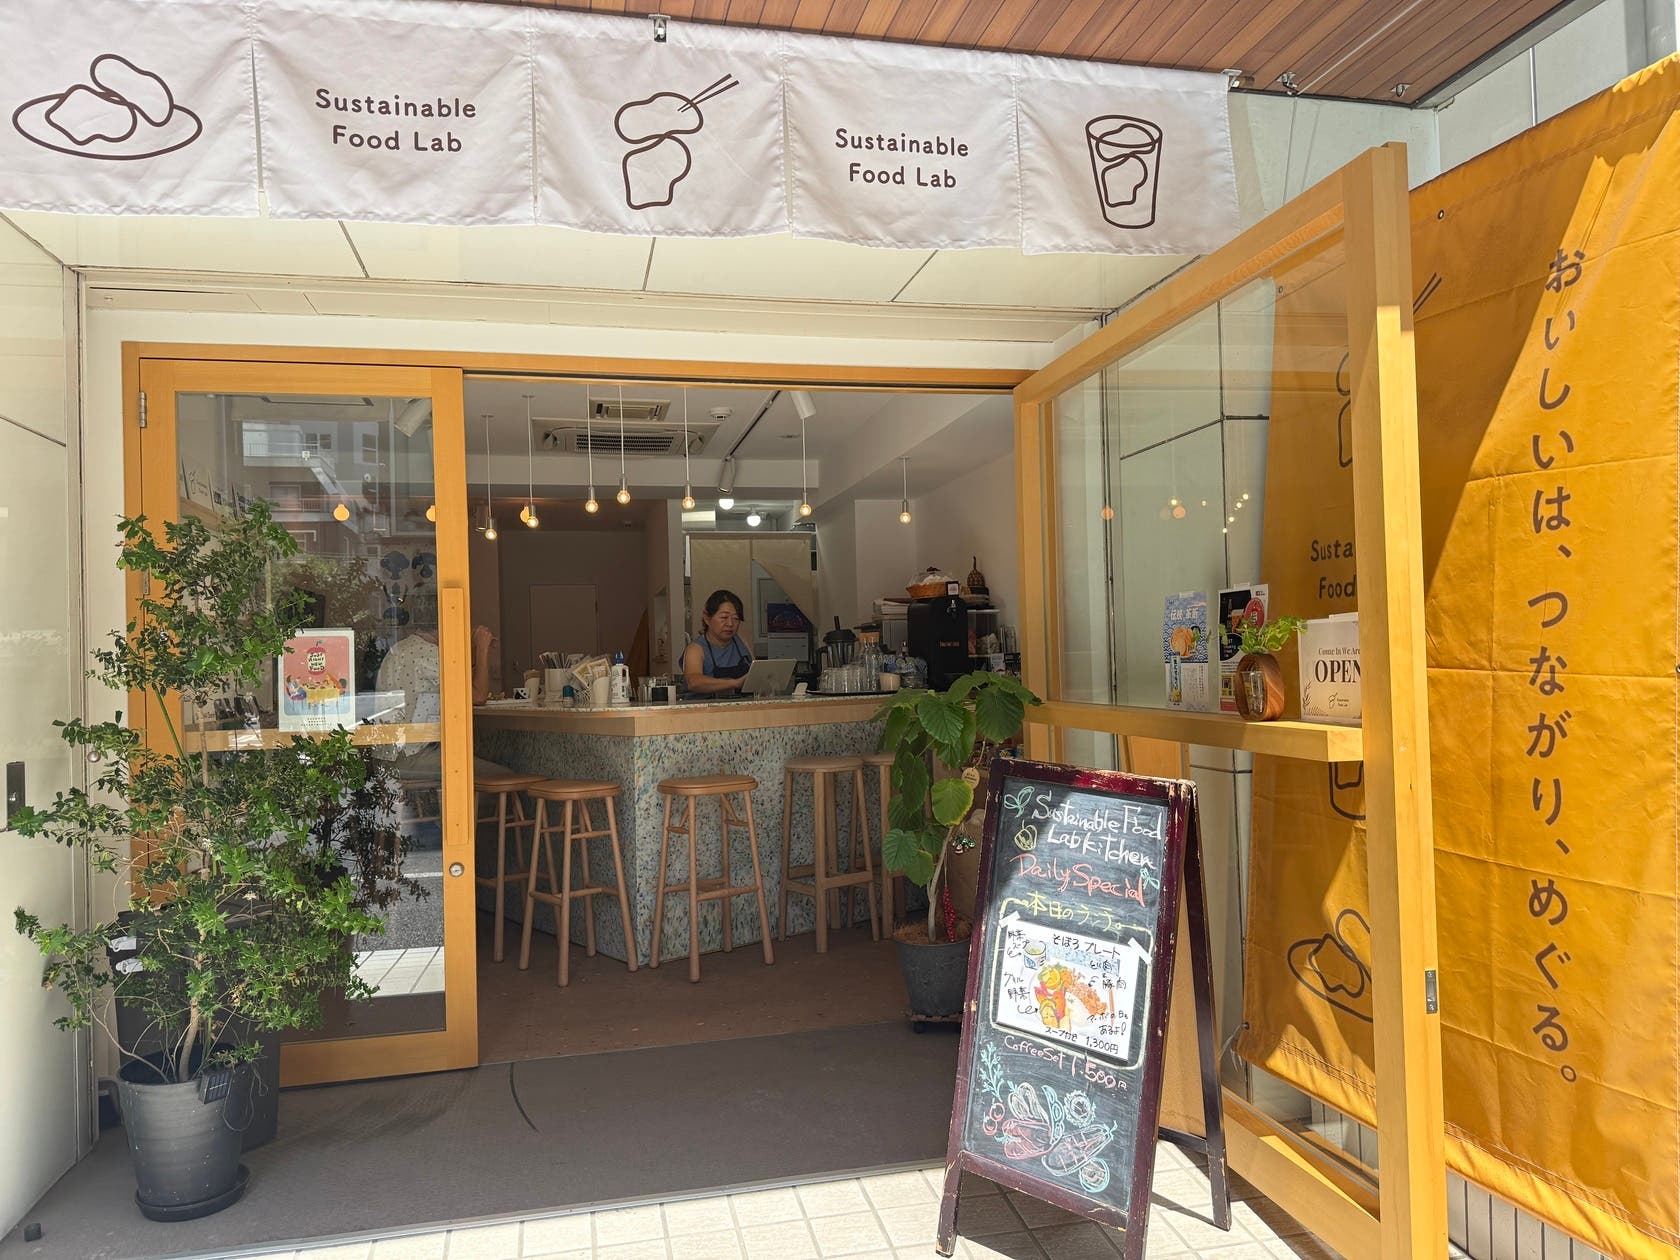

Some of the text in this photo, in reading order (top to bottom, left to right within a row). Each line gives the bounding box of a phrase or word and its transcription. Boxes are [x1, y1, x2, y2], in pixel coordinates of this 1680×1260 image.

[315, 88, 477, 118] Sustainable
[332, 124, 462, 152] Food Lab
[835, 128, 969, 157] Sustainable
[849, 162, 957, 188] Food Lab
[1318, 576, 1357, 599] Food
[1318, 647, 1335, 656] Come
[1342, 646, 1350, 655] We
[1031, 790, 1162, 840] Sustainable Food
[1010, 853, 1146, 908] Daily Special
[1052, 934, 1121, 959] そぼろ プレート
